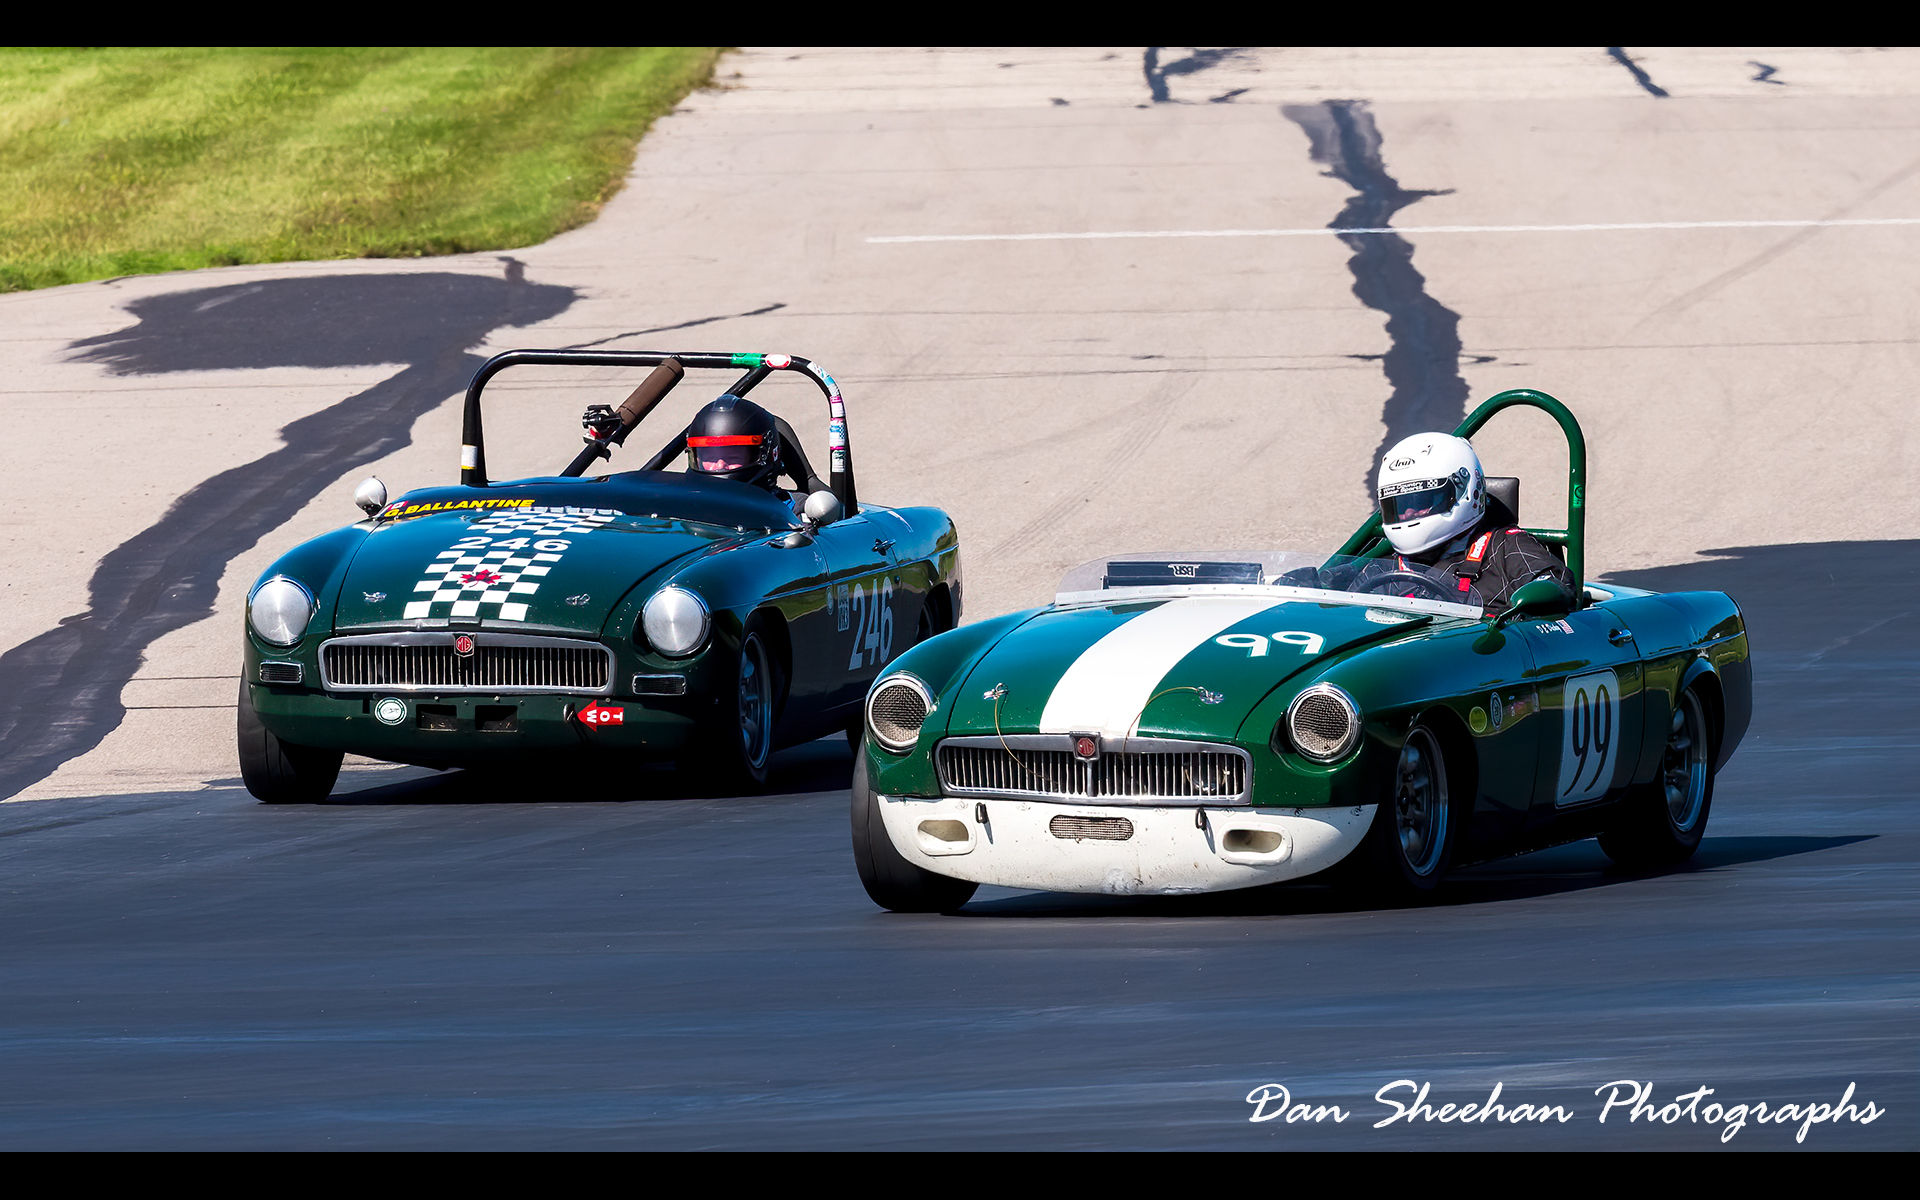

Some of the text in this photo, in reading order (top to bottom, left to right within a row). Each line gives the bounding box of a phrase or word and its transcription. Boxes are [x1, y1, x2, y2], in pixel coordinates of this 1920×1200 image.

[384, 499, 535, 518] G.BALLANTINE
[449, 536, 573, 552] 246
[848, 576, 893, 671] 246
[457, 637, 472, 651] MG
[1213, 630, 1327, 657] 99
[586, 710, 623, 724] TOW
[1078, 738, 1095, 756] MG
[1563, 684, 1611, 797] 99
